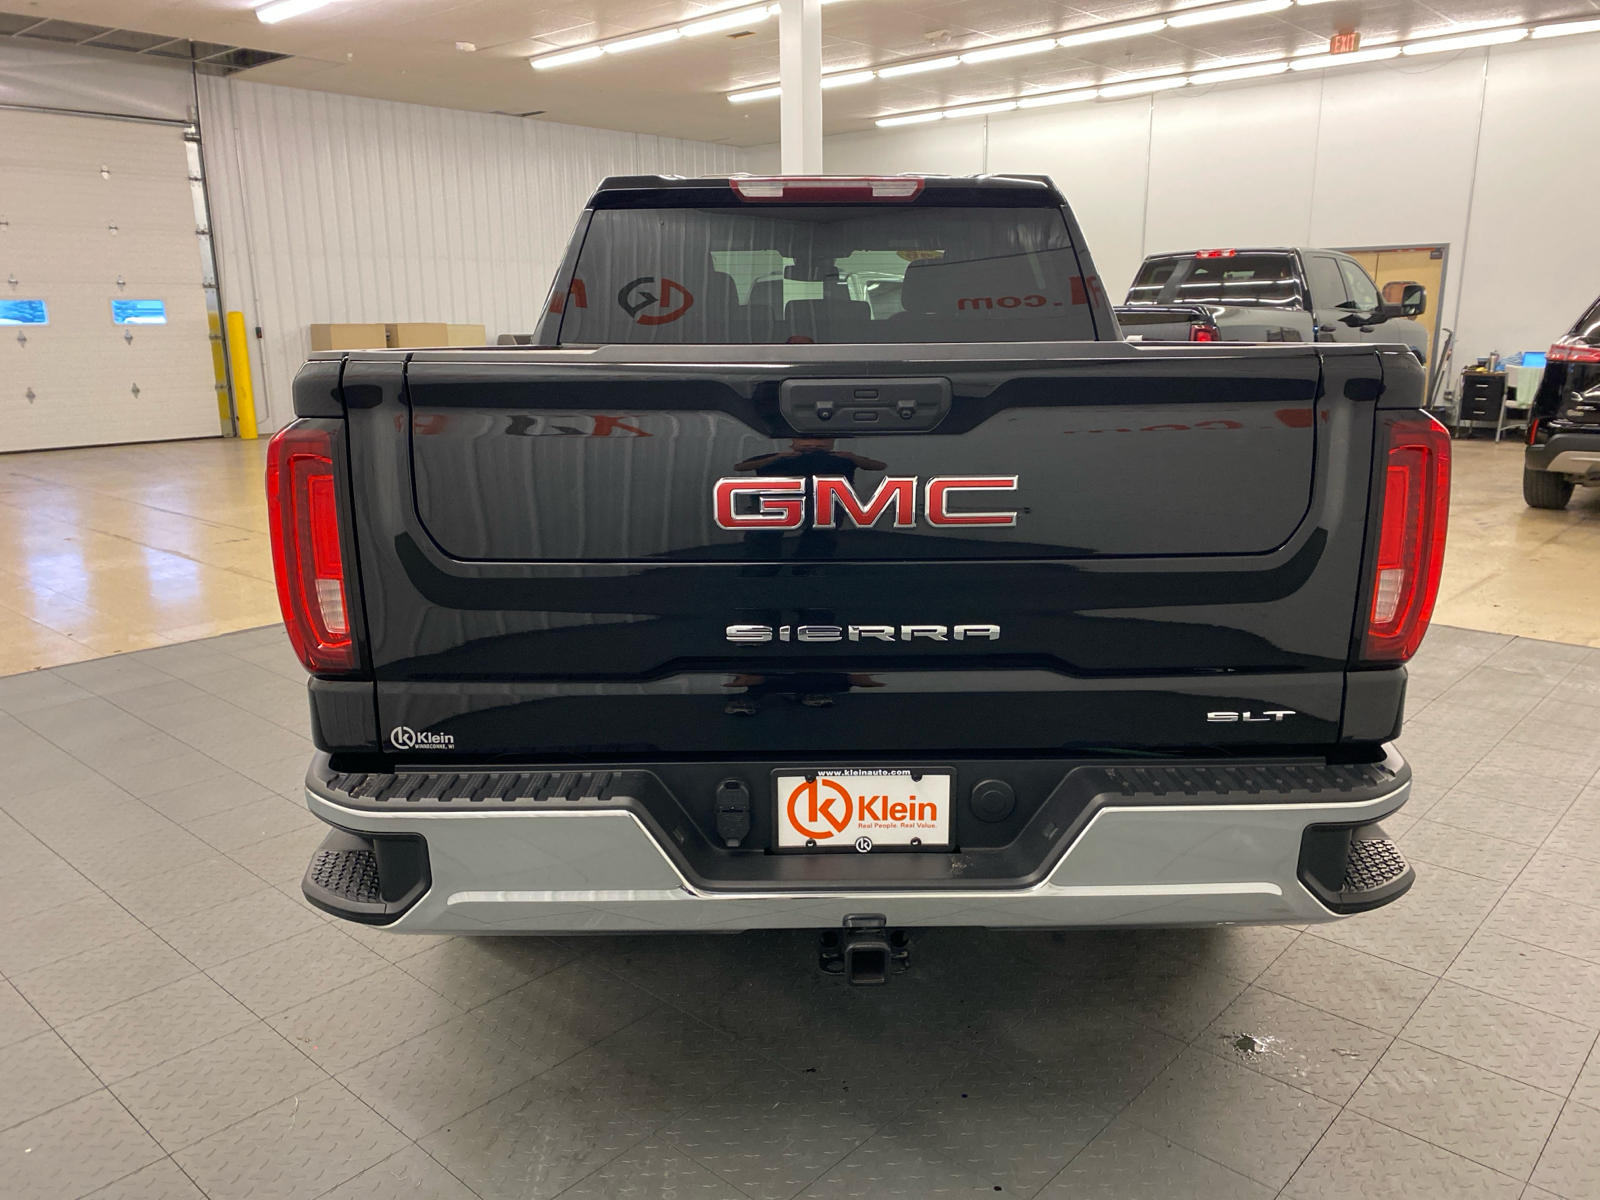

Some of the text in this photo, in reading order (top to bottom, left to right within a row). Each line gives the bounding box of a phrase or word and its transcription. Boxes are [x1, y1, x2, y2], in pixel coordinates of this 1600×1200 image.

[1334, 34, 1356, 53] EXIT
[713, 475, 1019, 531] GMC
[725, 624, 1001, 643] SIERRA
[1206, 710, 1297, 722] SLT
[417, 732, 454, 743] Klein
[818, 768, 911, 777] www.kleinauto.com
[858, 795, 937, 821] Klein
[858, 822, 873, 830] Real
[874, 822, 899, 831] People.
